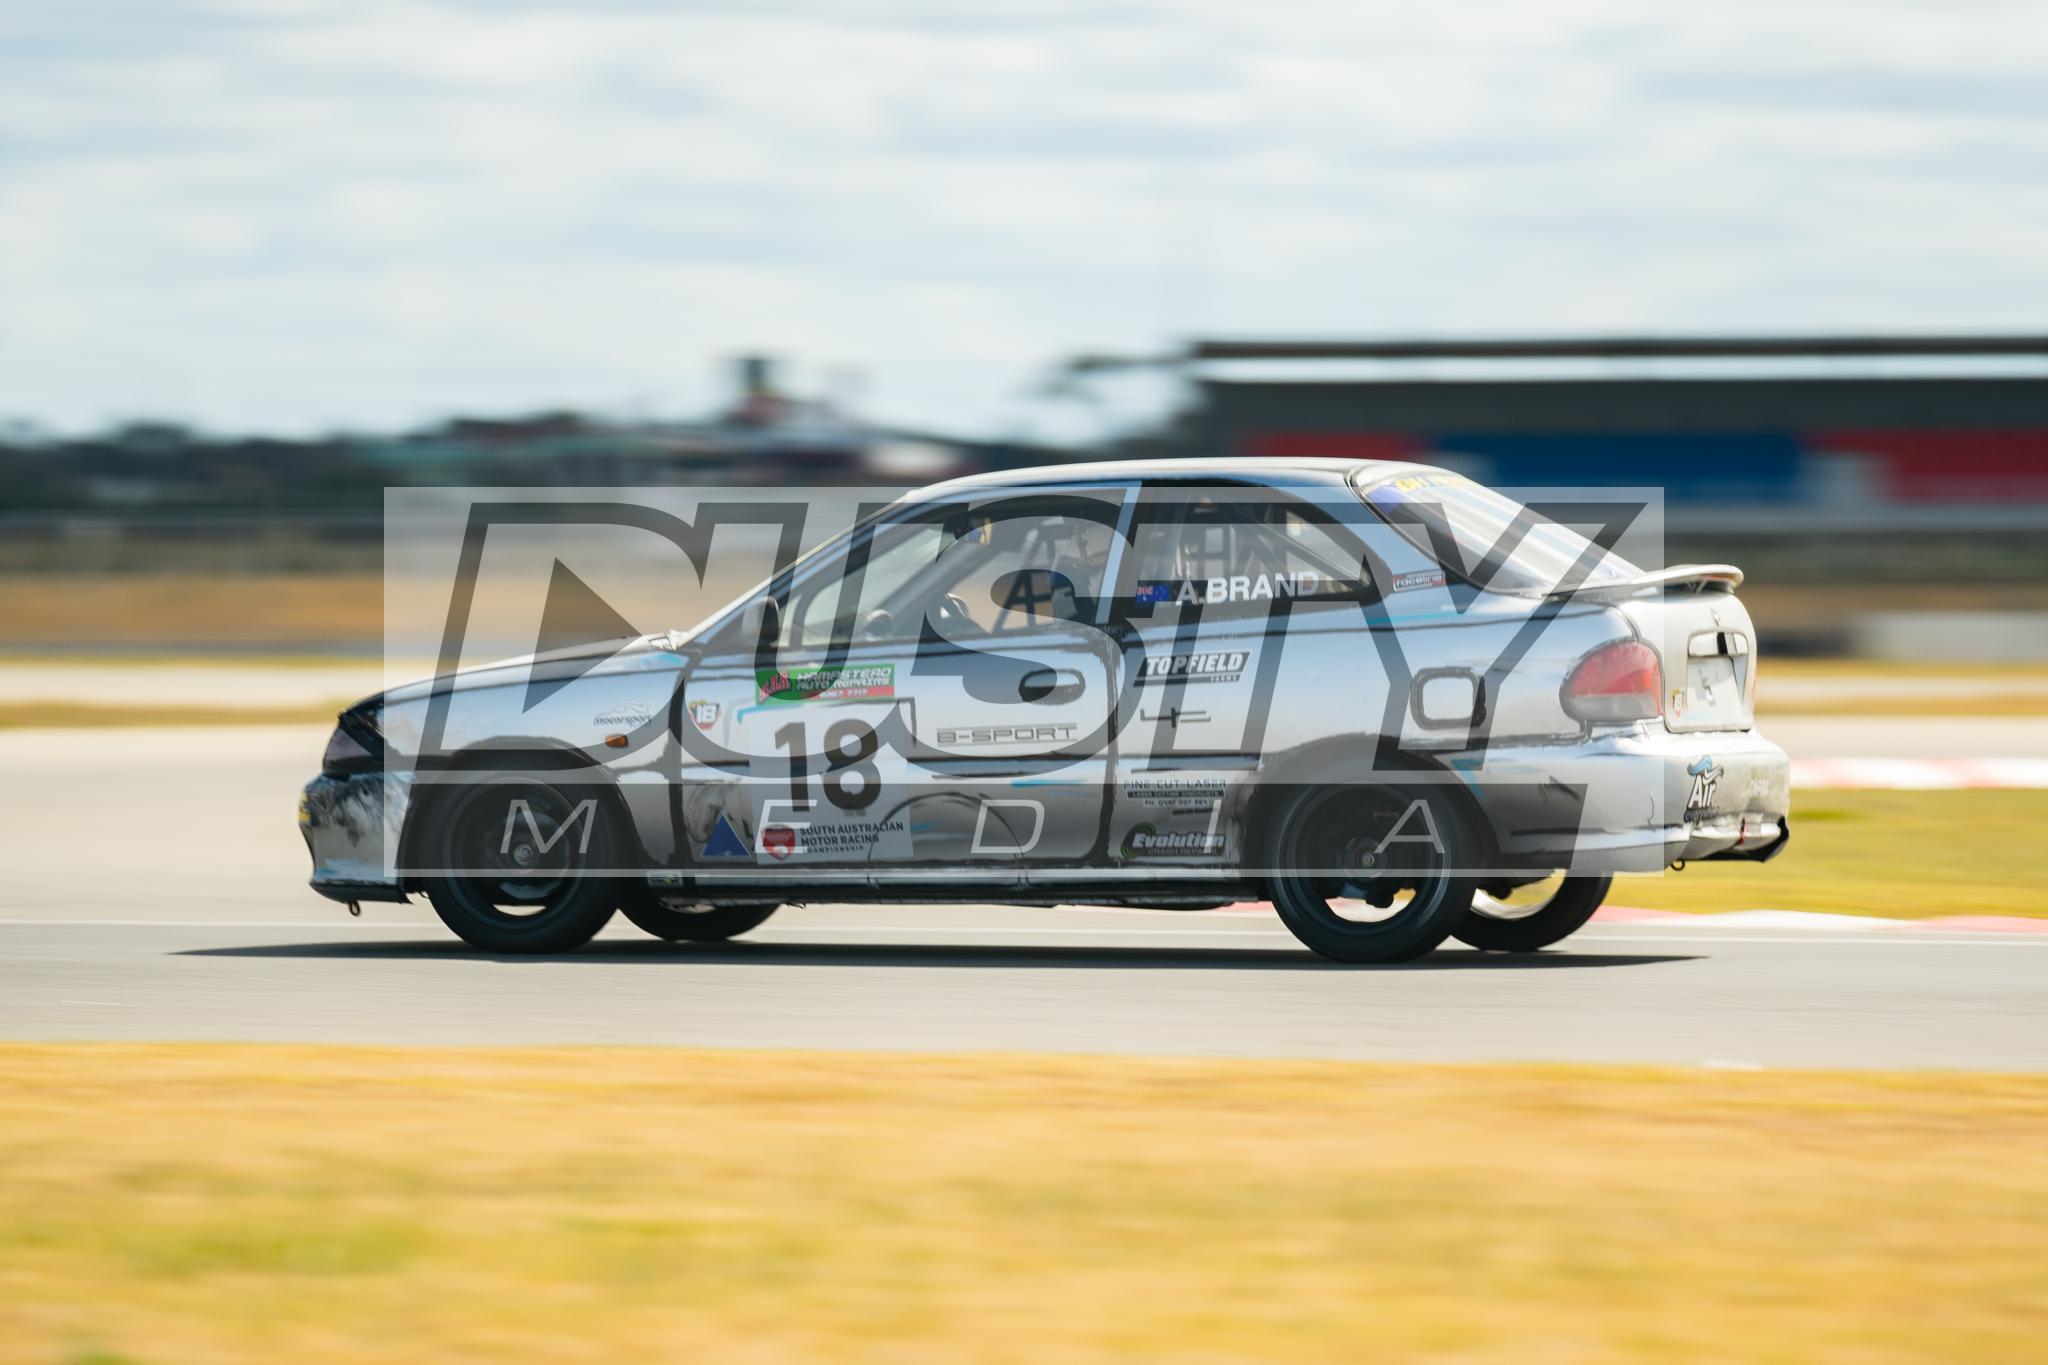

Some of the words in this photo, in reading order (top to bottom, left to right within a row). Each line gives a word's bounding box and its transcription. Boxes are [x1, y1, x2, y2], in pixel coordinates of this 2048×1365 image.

[1175, 571, 1319, 607] A.BRAND
[1146, 653, 1243, 676] TOPFIELD
[937, 727, 1077, 744] B-SPORT
[774, 718, 882, 812] 18
[1688, 773, 1716, 808] Air
[800, 826, 835, 836] SOUTH
[837, 821, 904, 835] AUSTRALIAN
[800, 836, 838, 847] MOTOR
[840, 834, 880, 845] RACING
[1132, 832, 1225, 848] Evolution
